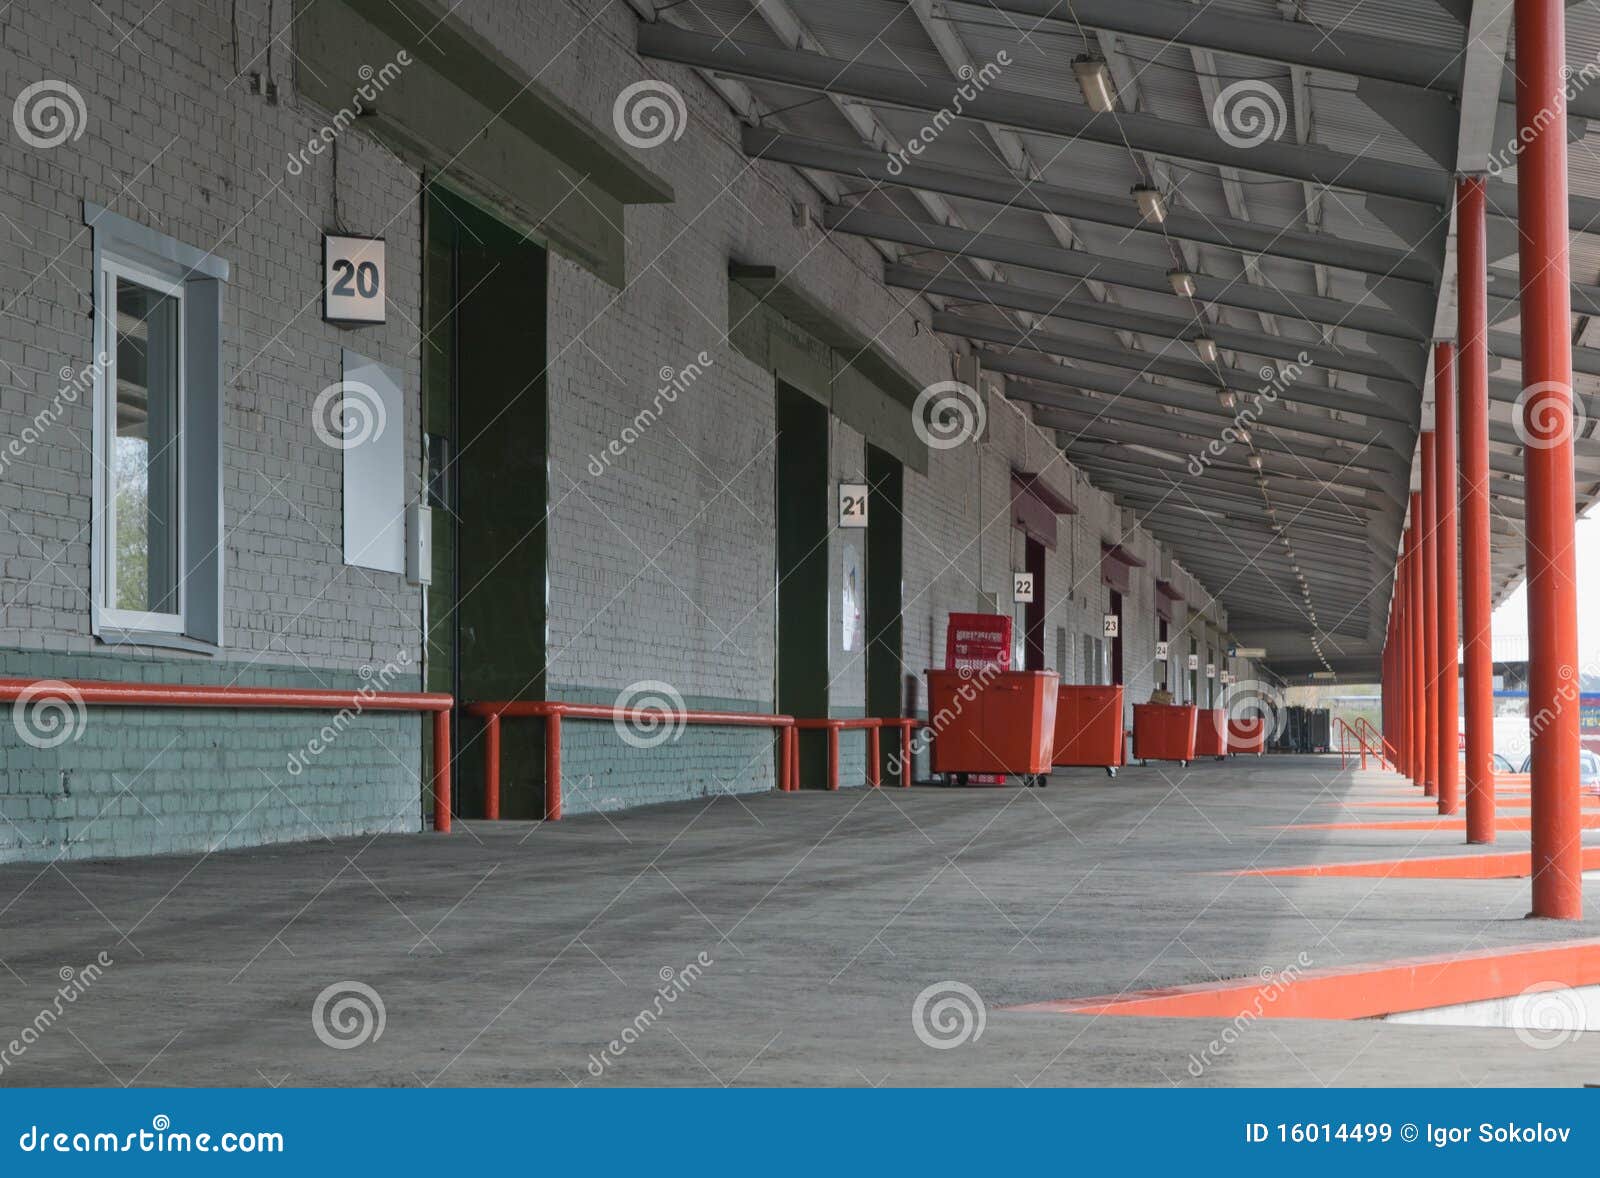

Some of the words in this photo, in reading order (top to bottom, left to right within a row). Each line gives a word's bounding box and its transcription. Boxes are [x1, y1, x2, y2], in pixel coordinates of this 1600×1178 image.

[331, 259, 380, 298] 20
[842, 496, 865, 516] 21
[1016, 580, 1031, 594] 22
[1105, 620, 1117, 631] 23
